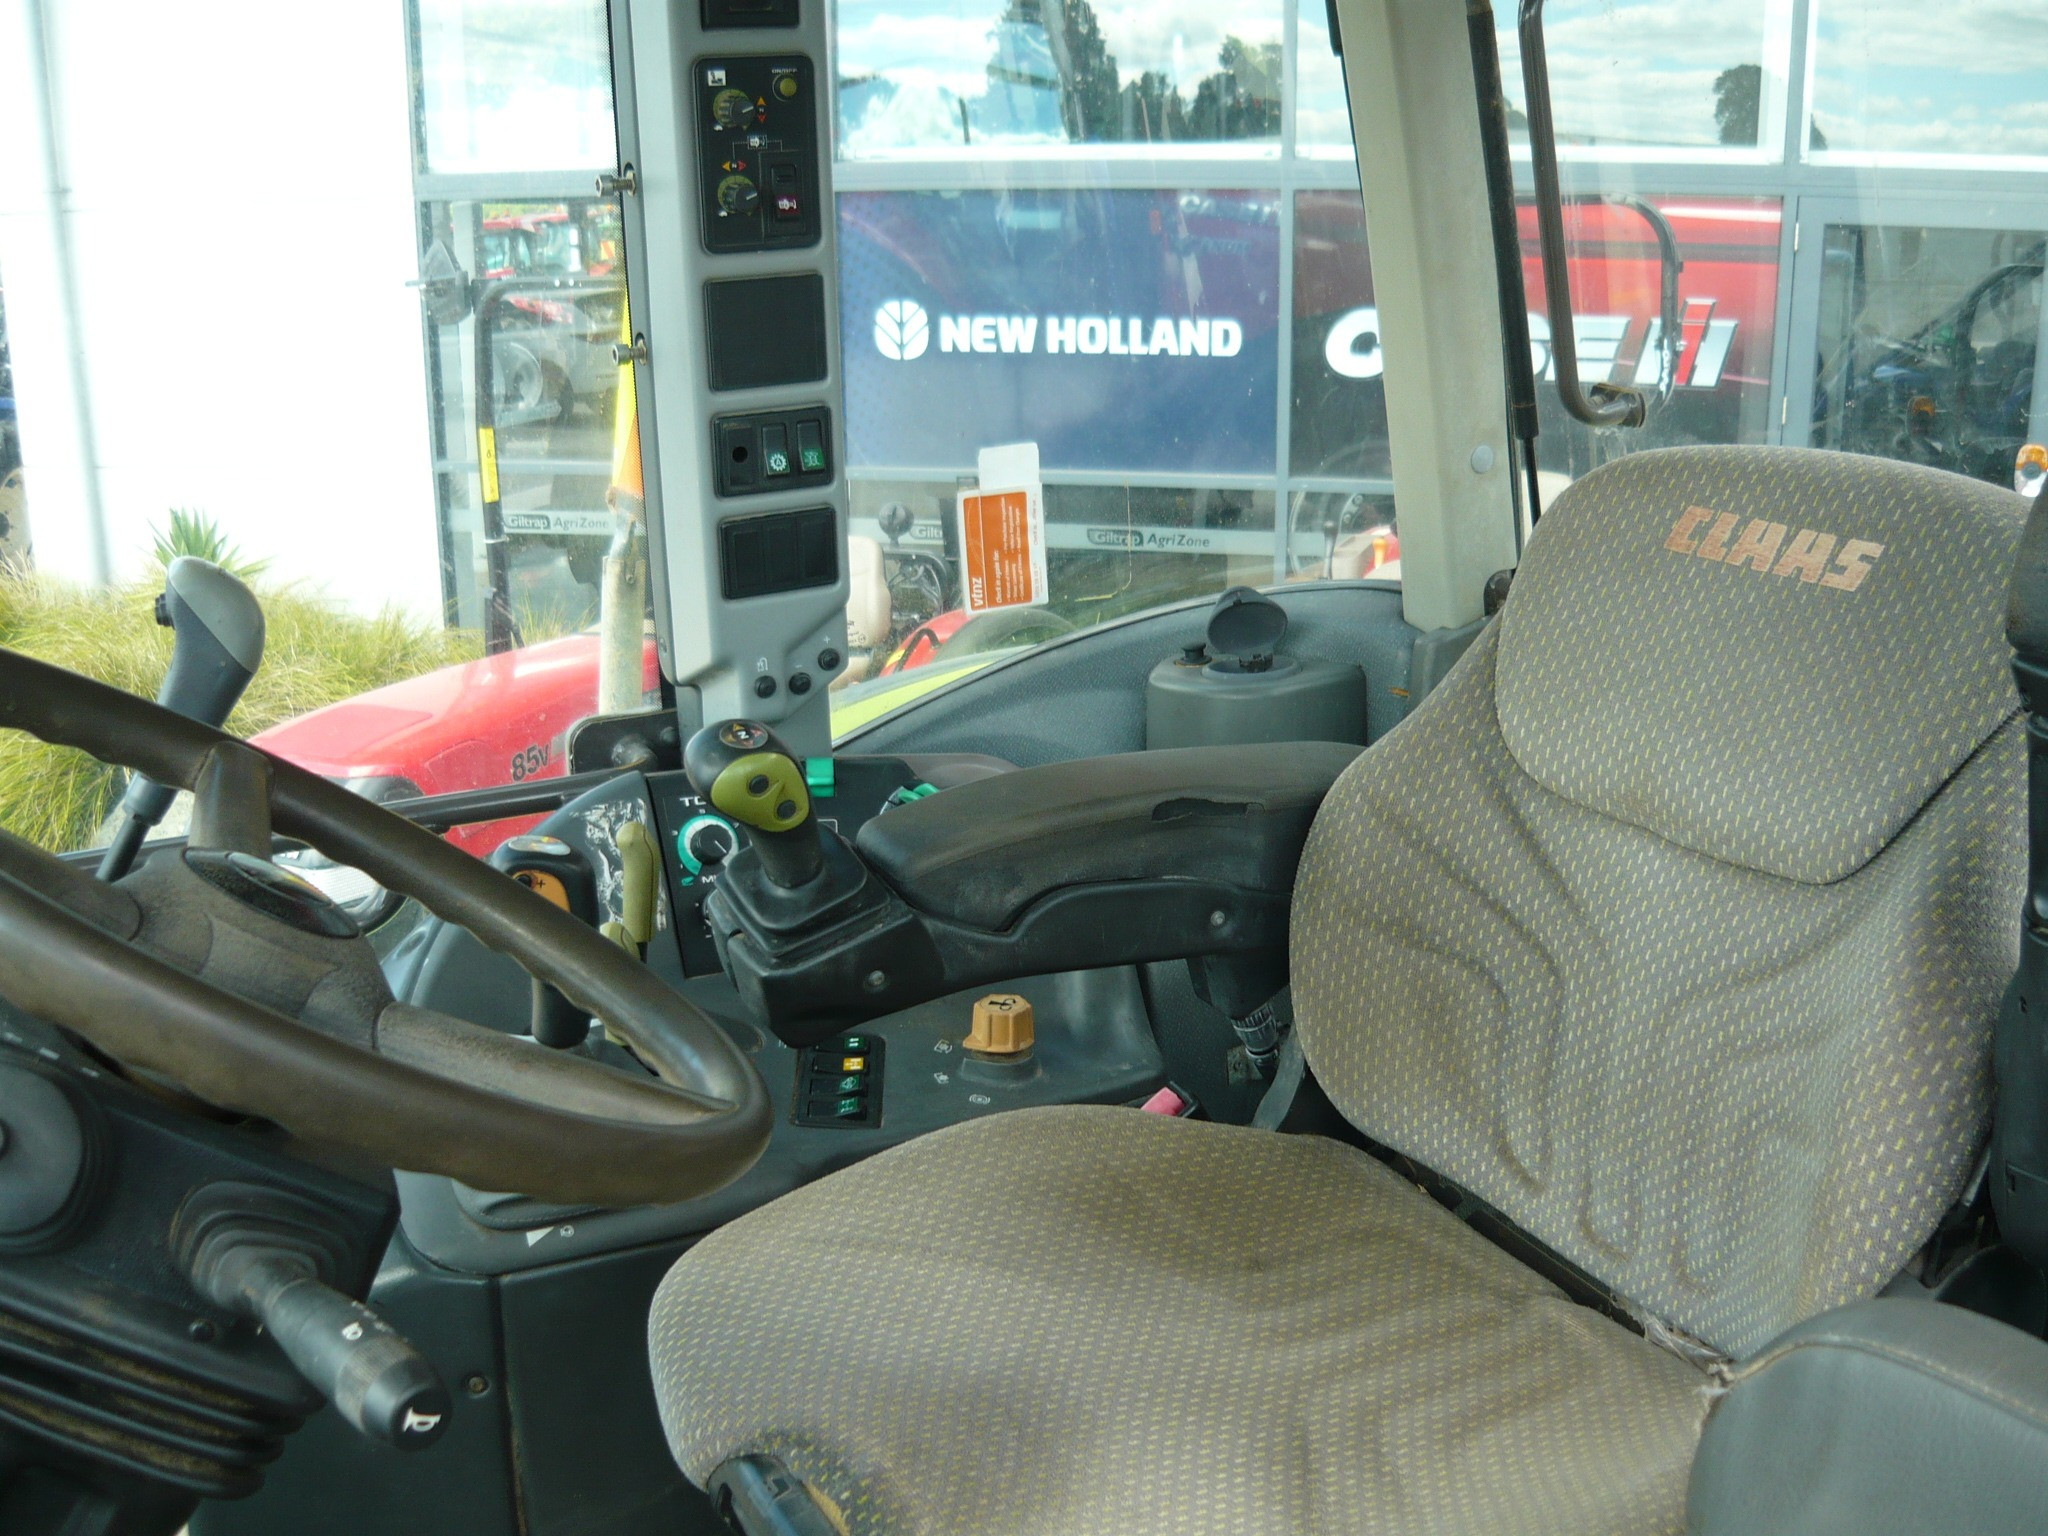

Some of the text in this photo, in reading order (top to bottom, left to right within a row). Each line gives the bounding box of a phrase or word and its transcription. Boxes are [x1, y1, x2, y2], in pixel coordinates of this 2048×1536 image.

[938, 316, 1243, 358] NEW HOLLAND
[510, 514, 609, 532] Giltrap AgriZone
[1147, 533, 1211, 549] AgriZone
[1664, 505, 1886, 592] CLAAS
[971, 576, 983, 607] vtnz
